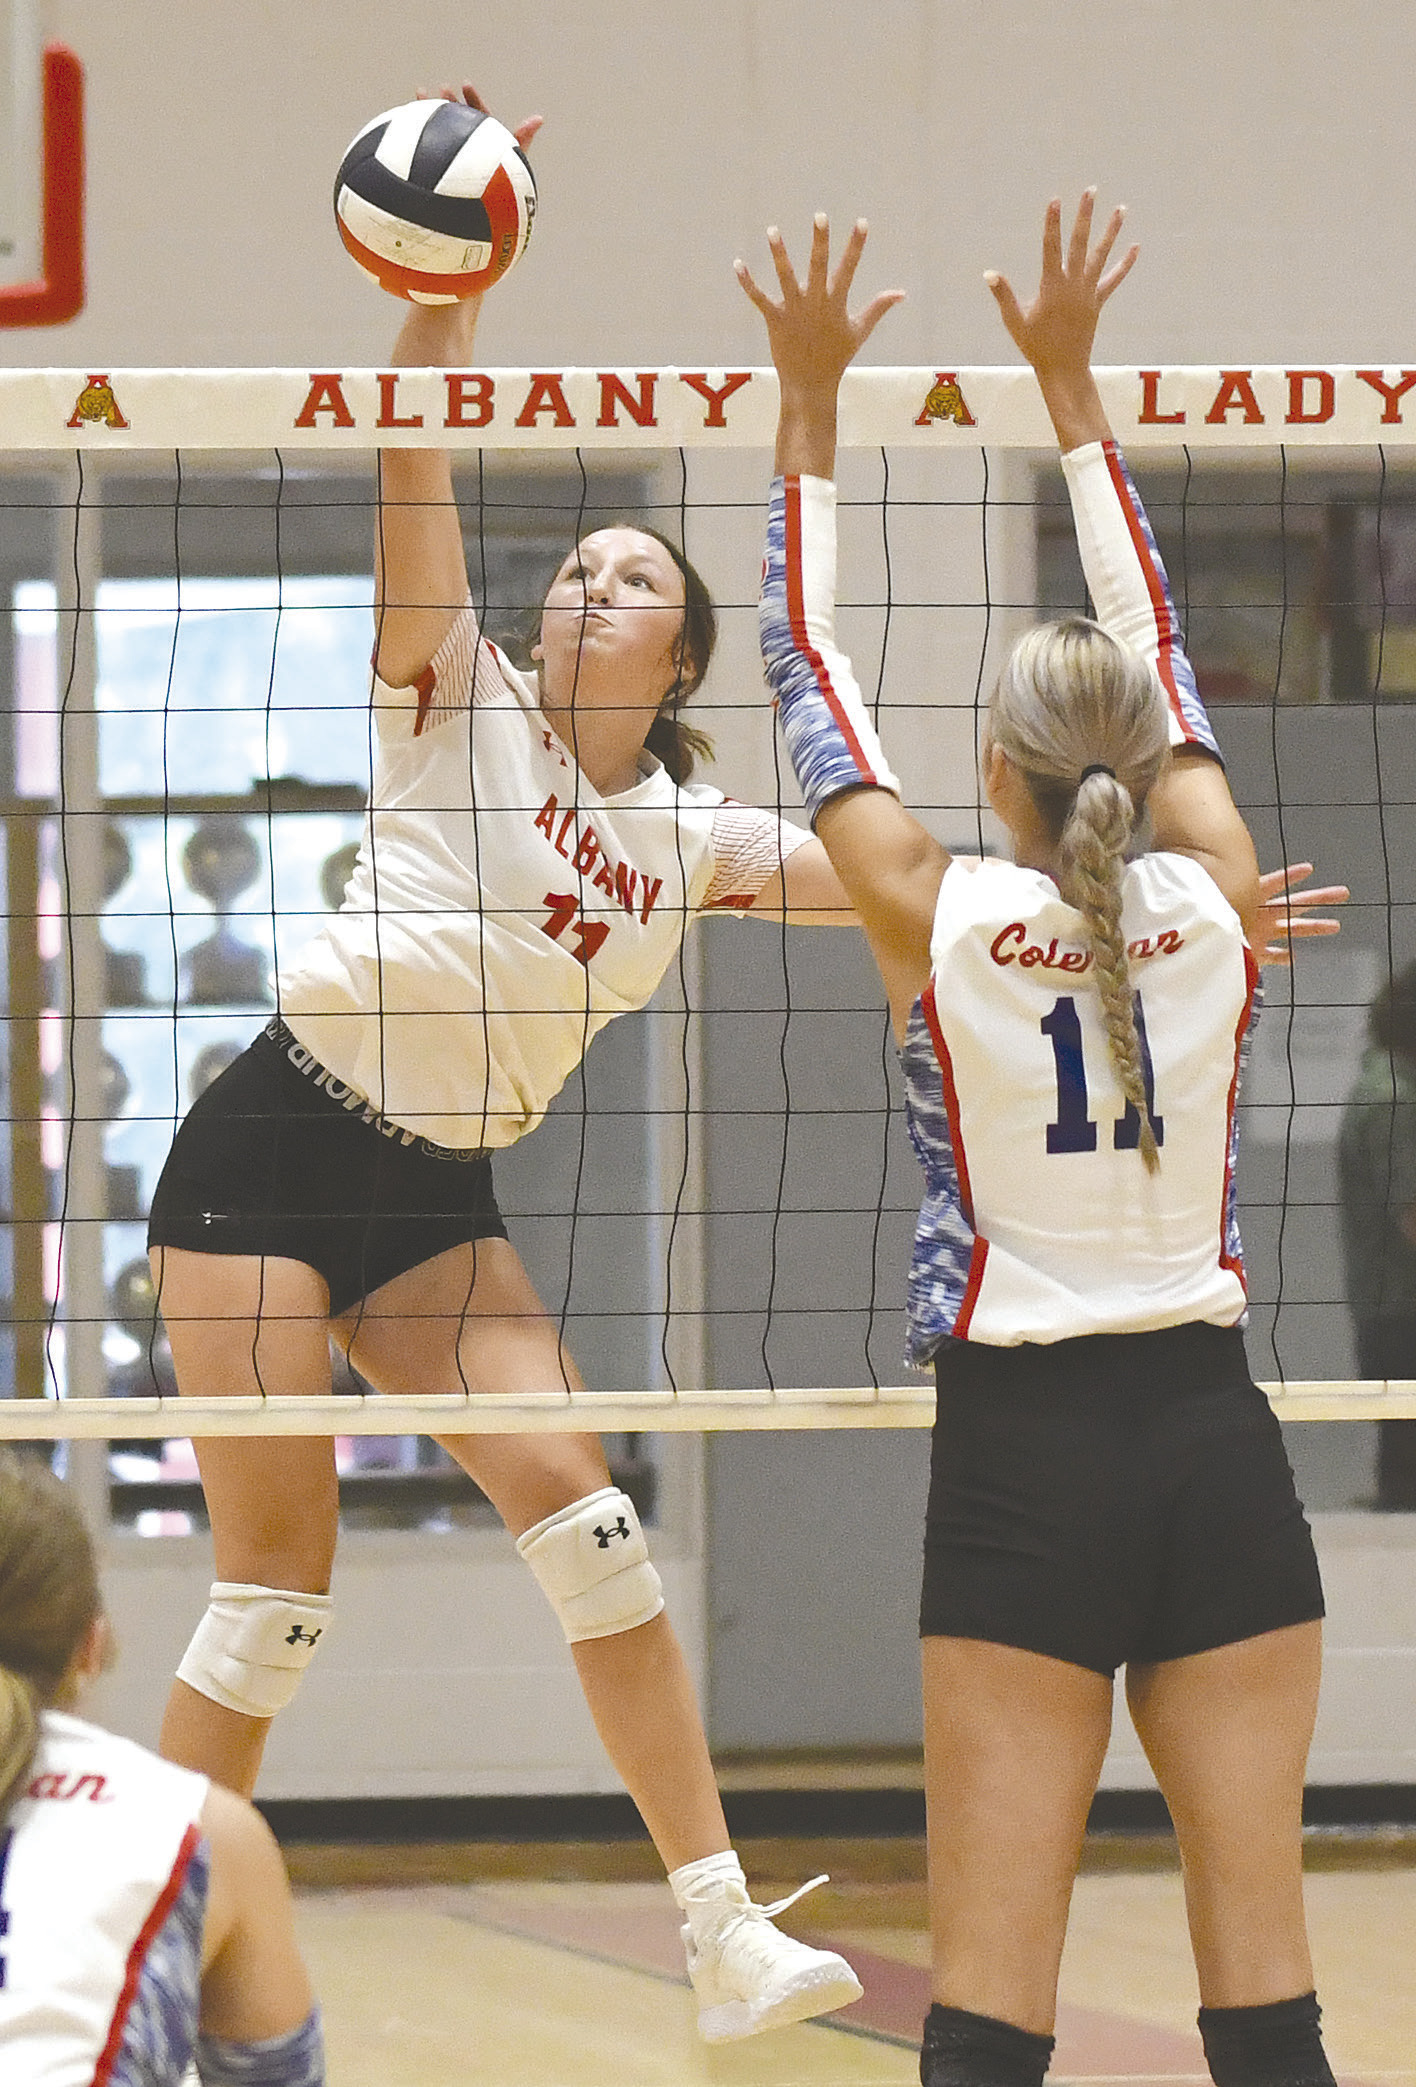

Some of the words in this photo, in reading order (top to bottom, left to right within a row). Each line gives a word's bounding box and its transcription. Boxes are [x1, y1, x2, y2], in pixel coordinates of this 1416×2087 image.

[294, 373, 752, 427] ALBANY
[1138, 370, 1416, 424] LADY
[534, 793, 664, 926] ALBANY
[990, 922, 1185, 973] Colean
[1040, 989, 1164, 1154] 11
